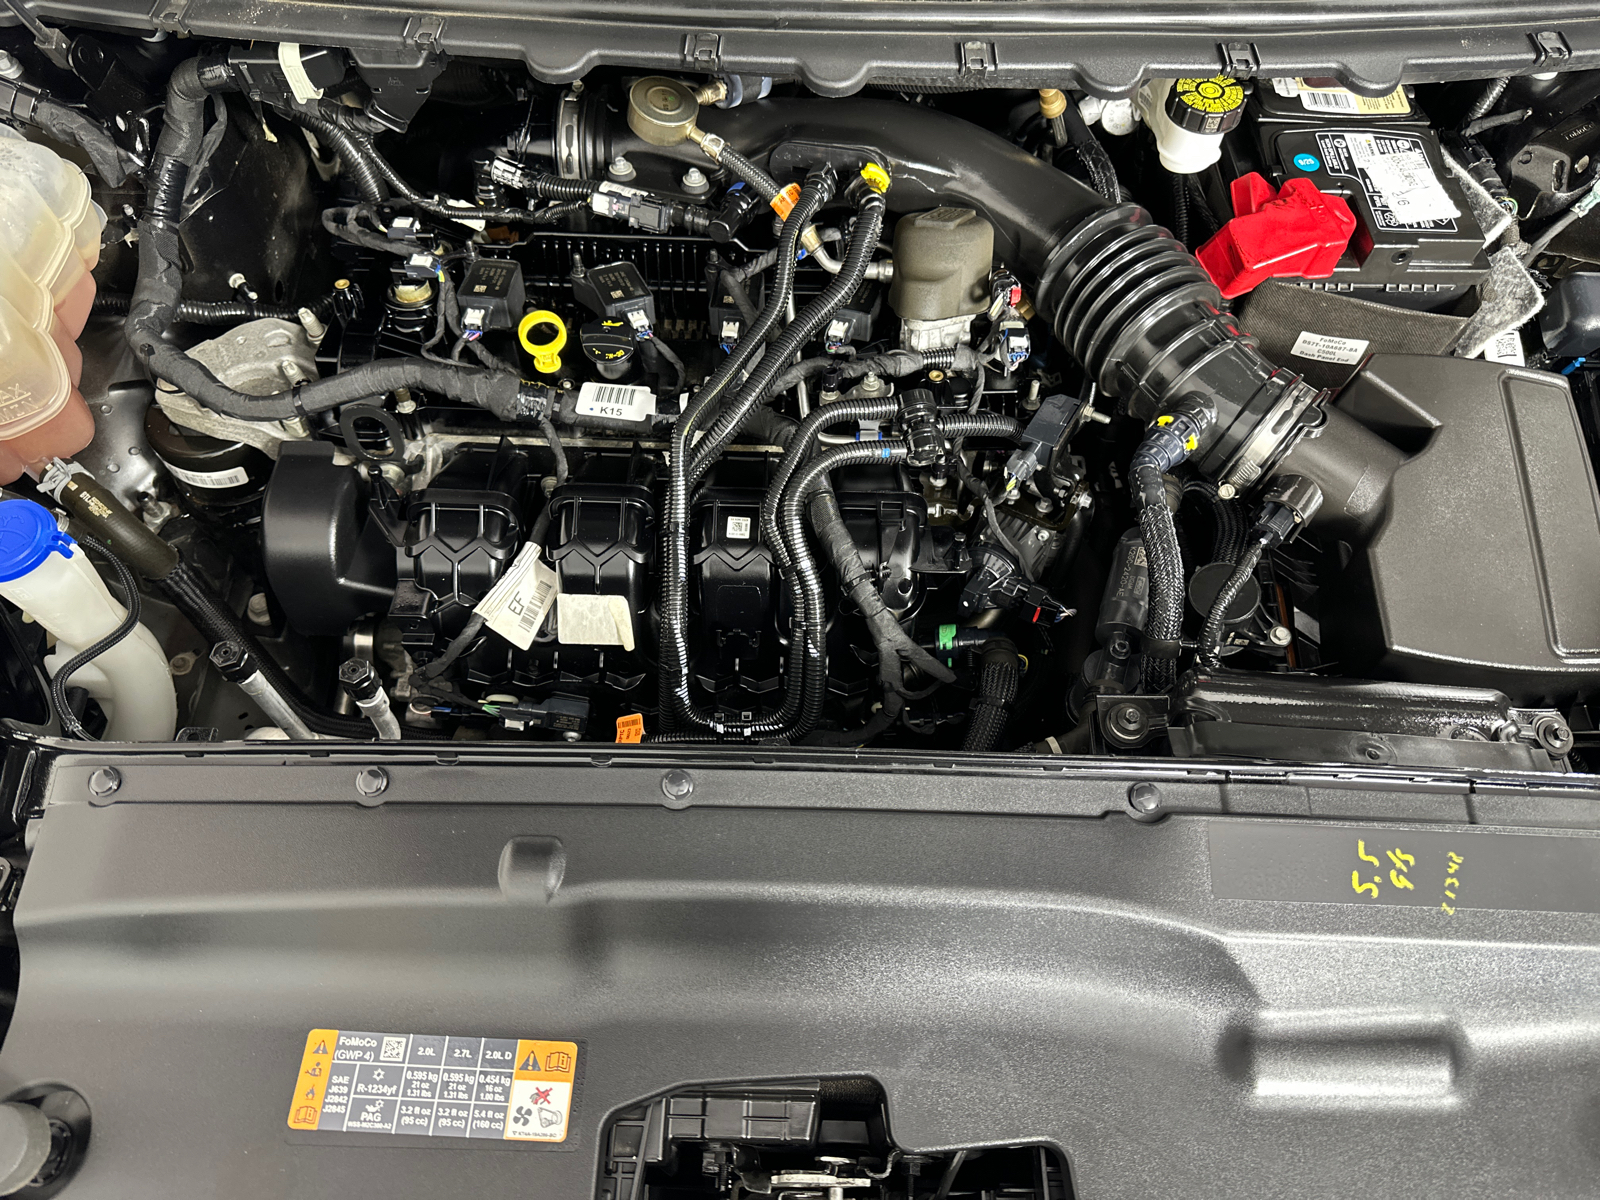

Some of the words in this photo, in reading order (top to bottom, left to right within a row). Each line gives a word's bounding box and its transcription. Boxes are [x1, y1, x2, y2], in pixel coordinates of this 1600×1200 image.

[1319, 337, 1346, 345] FoMoCo
[1299, 350, 1315, 358] Dash
[599, 406, 623, 416] K15
[507, 590, 525, 616] EF
[339, 1036, 377, 1047] FoMoCo
[334, 1049, 363, 1060] (GWP
[364, 1051, 375, 1062] 4)
[417, 1047, 436, 1056] 2.0L
[453, 1049, 472, 1058] 2.7L
[485, 1051, 503, 1060] 2.0L
[505, 1052, 512, 1060] D
[331, 1075, 350, 1084] SAE
[406, 1070, 427, 1080] 0.595
[428, 1072, 439, 1083] kg
[443, 1072, 464, 1082] 0.595
[465, 1074, 475, 1085] kg
[479, 1074, 500, 1084] 0.454
[501, 1075, 511, 1086] kg
[328, 1085, 348, 1093] J639
[411, 1081, 419, 1089] 21
[448, 1083, 455, 1091] 21
[356, 1084, 398, 1096] R-1234yf
[407, 1089, 420, 1097] 1.31
[421, 1089, 432, 1098] lbs
[443, 1091, 456, 1099] 1.31
[457, 1091, 468, 1100] lbs
[494, 1093, 505, 1102] lbs
[400, 1106, 413, 1115] 3.2
[421, 1108, 431, 1116] oz
[437, 1107, 450, 1116] 3.2
[473, 1109, 486, 1118] 5.4
[494, 1111, 504, 1119] oz
[360, 1112, 381, 1122] PAG
[401, 1116, 414, 1126] (95
[415, 1118, 428, 1127] cc)
[438, 1118, 451, 1127] (95
[452, 1119, 465, 1128] cc)
[490, 1121, 504, 1130] cc)
